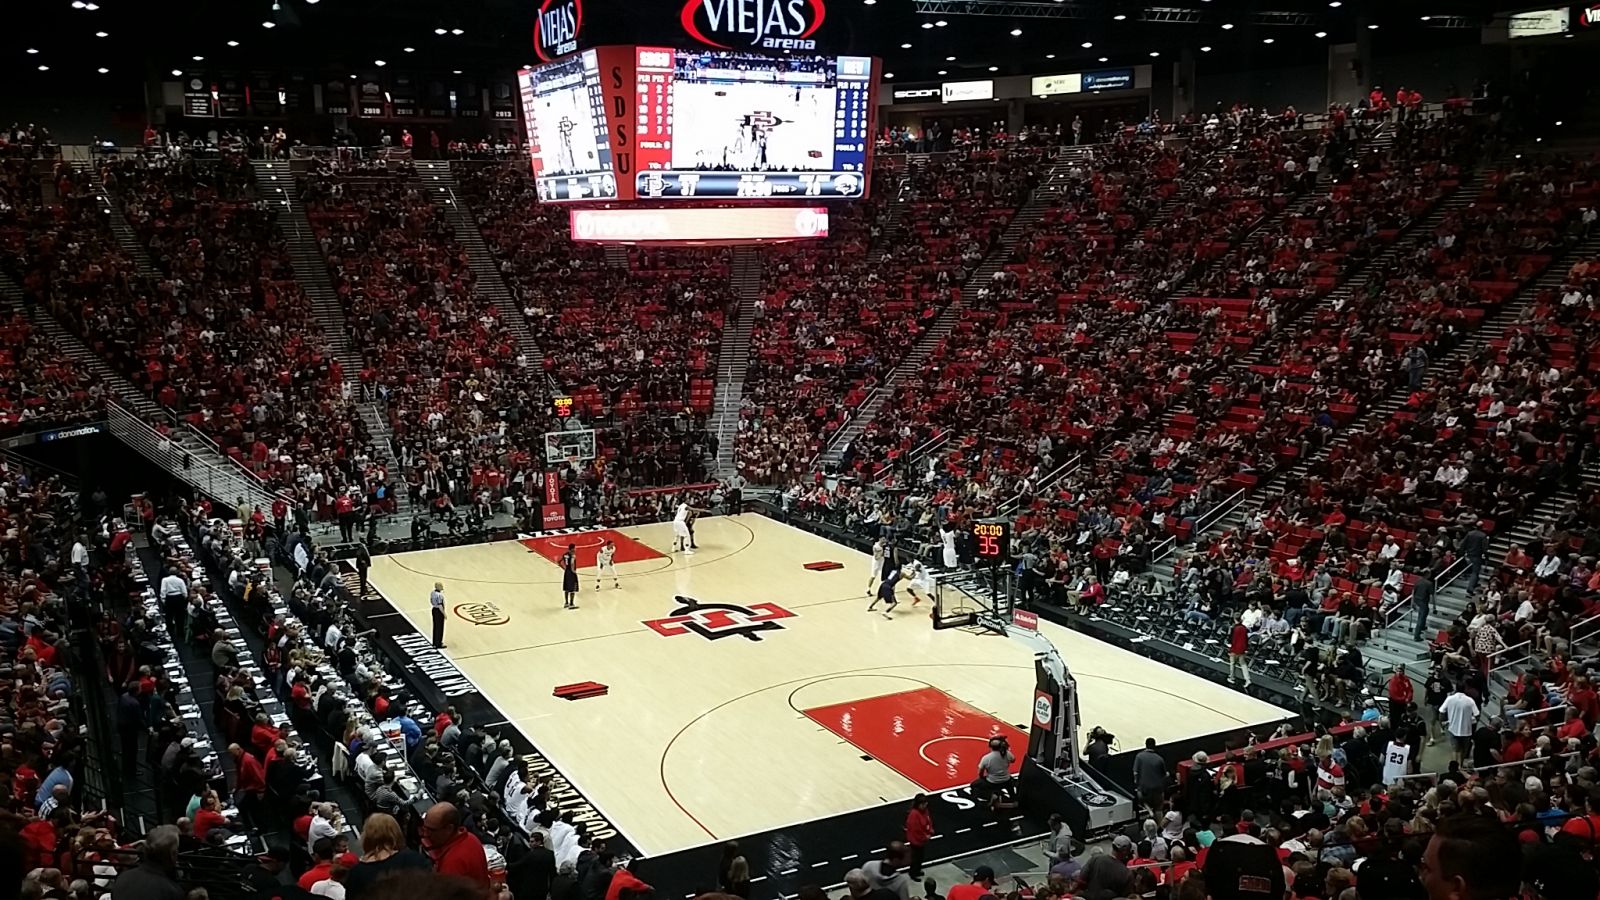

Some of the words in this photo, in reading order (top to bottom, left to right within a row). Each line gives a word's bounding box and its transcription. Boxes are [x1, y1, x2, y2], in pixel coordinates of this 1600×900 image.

[537, 2, 577, 48] VIEJAS
[703, 0, 806, 45] VIEJAS
[556, 40, 577, 55] arena
[762, 37, 816, 50] arena
[612, 66, 631, 175] SDSU
[554, 398, 573, 406] 20:00
[558, 406, 571, 416] 35
[973, 524, 1003, 536] 20:00
[979, 536, 999, 555] 35
[391, 632, 439, 656] STATE
[1390, 752, 1404, 765] 23
